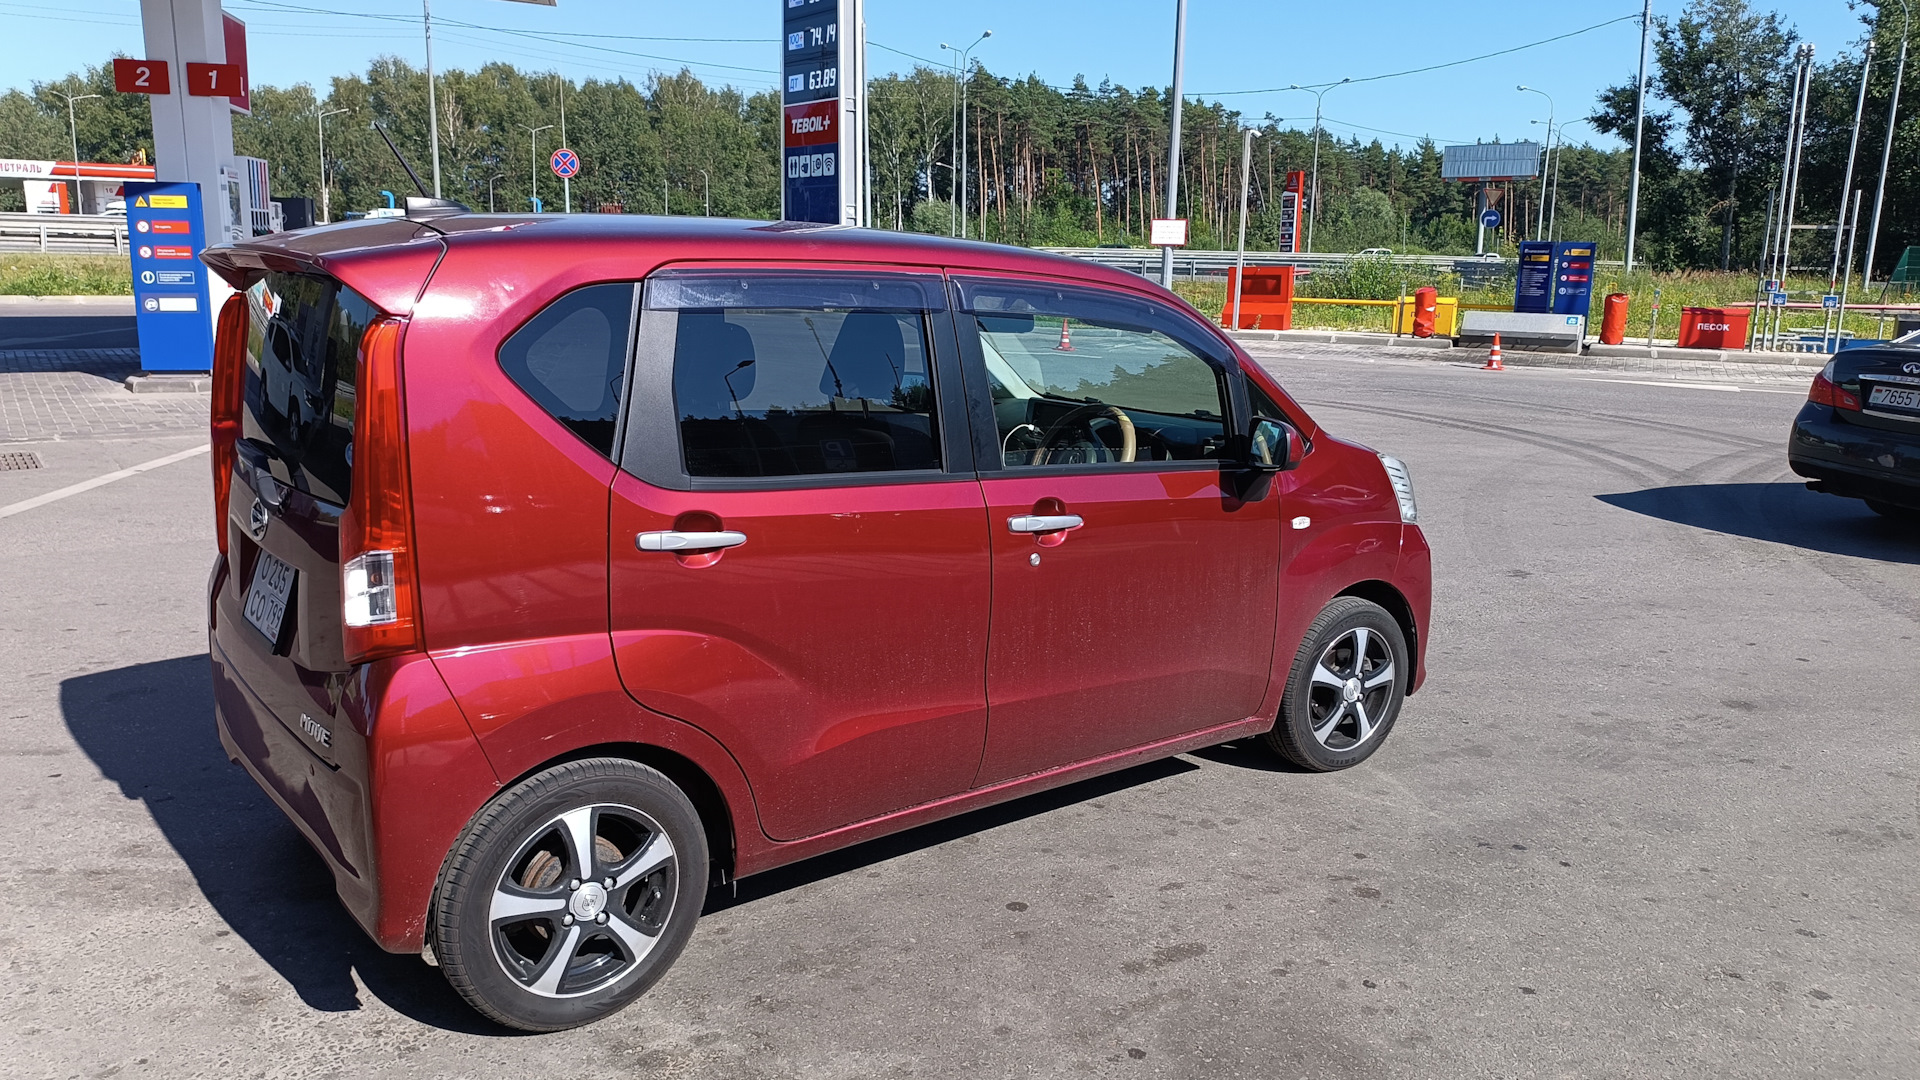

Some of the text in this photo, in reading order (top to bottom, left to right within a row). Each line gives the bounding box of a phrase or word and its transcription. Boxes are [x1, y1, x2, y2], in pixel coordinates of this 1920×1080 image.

[810, 23, 836, 47] 74.14
[135, 66, 150, 87] 2
[208, 70, 218, 89] 1
[790, 67, 836, 90] ДТ 63.89
[1697, 323, 1730, 331] ПЕСОК
[1881, 389, 1915, 406] 7655
[300, 712, 332, 748] MOVE
